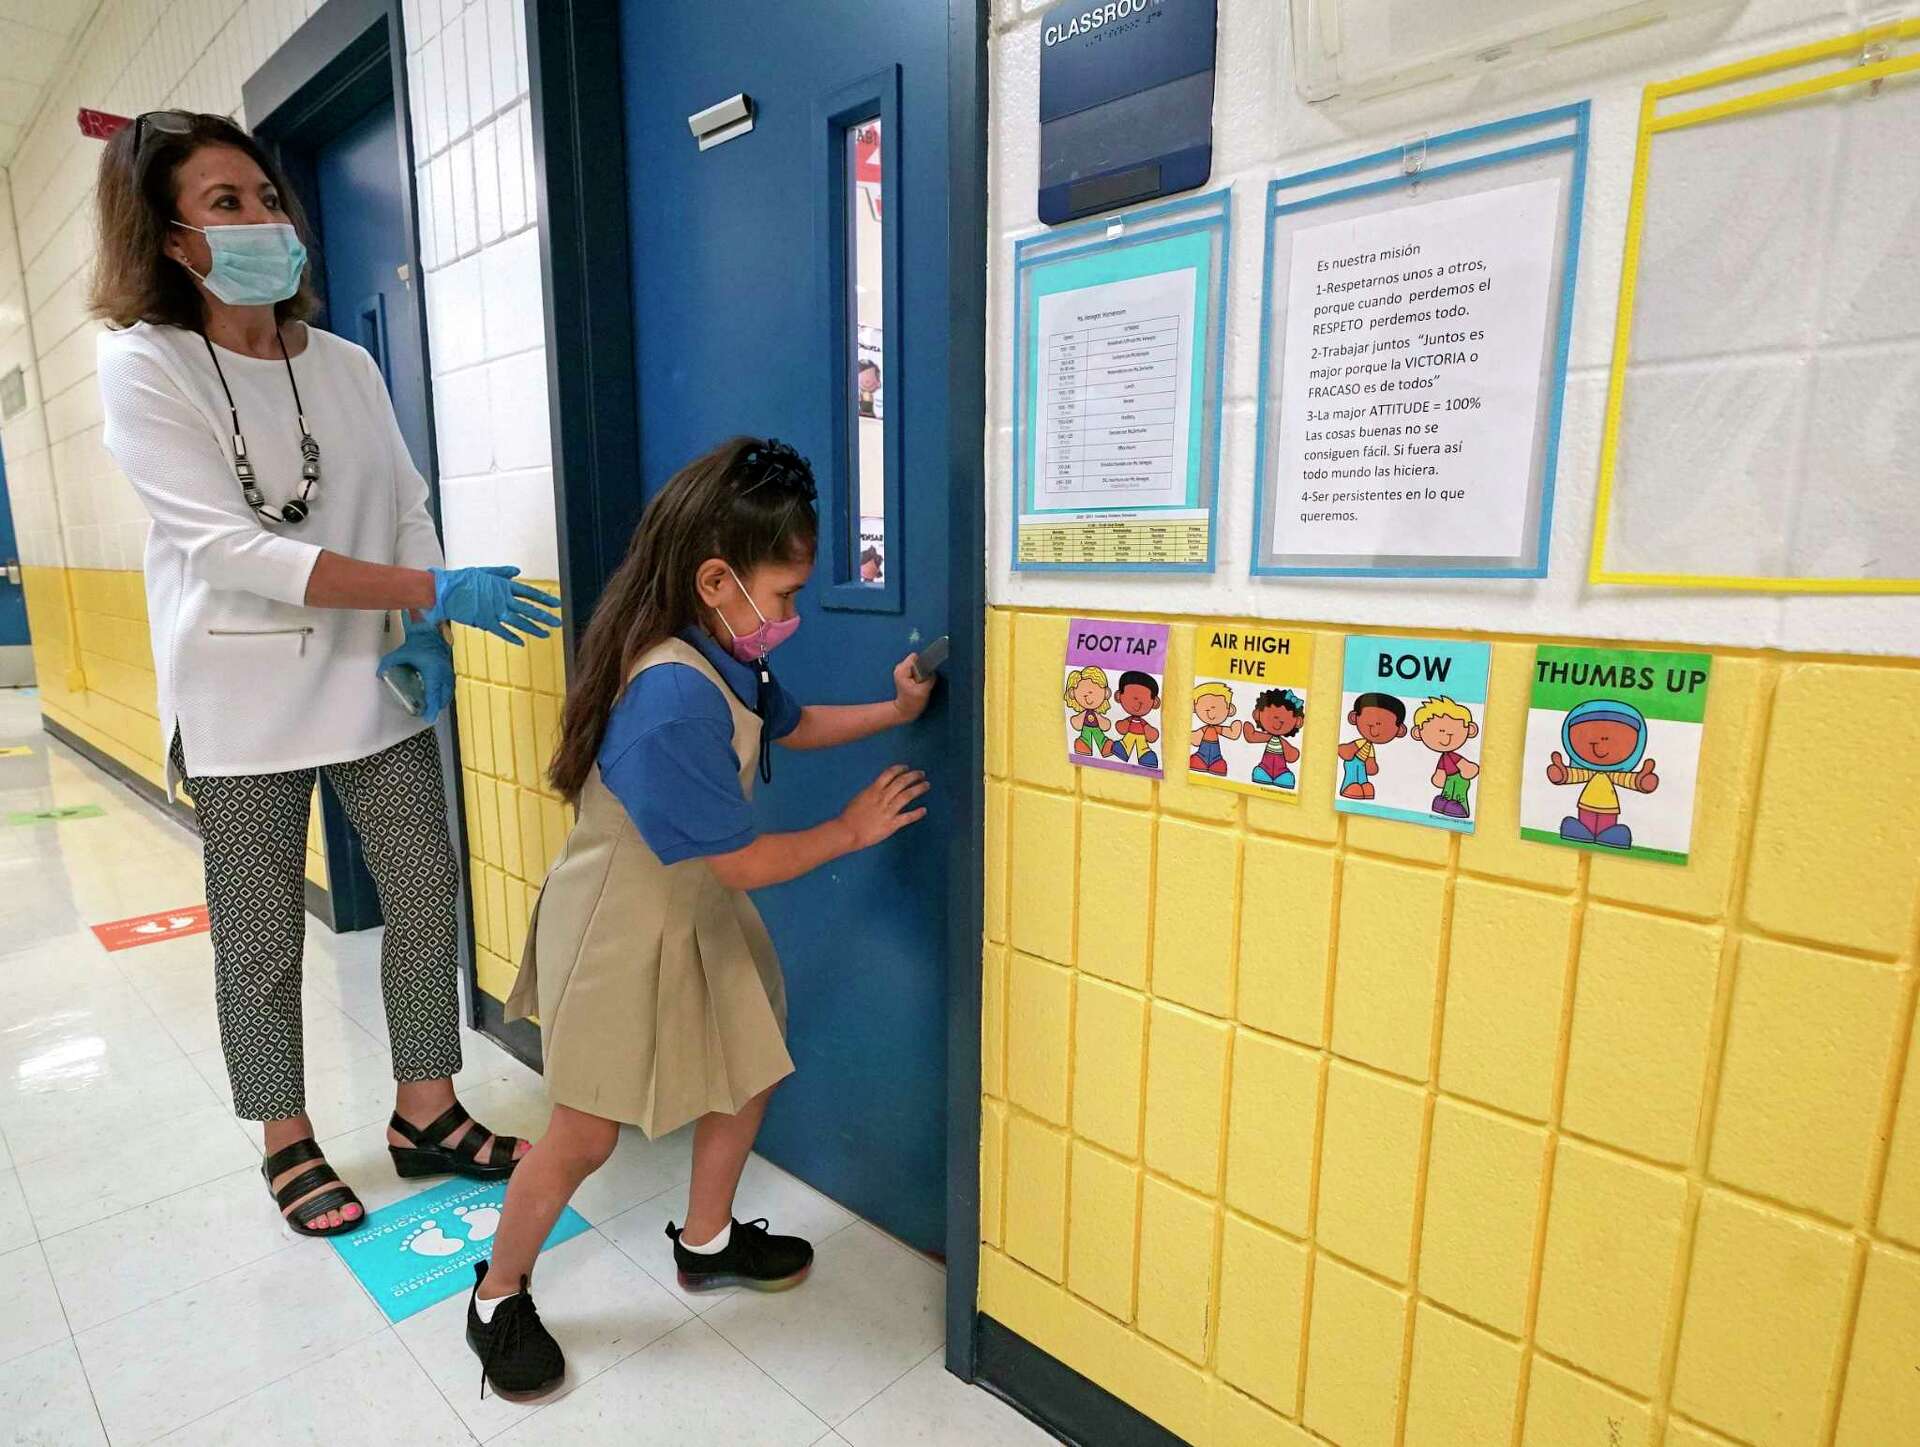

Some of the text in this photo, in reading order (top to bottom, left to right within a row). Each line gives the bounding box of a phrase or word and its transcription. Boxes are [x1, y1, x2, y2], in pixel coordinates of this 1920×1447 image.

[1316, 244, 1421, 272] Es nuestra misión
[1316, 259, 1487, 296] 1-Respetarnos unos a otros,
[1313, 277, 1491, 318] porque cuando perdemos el
[1312, 303, 1470, 336] RESPETO perdemos todo.
[1311, 343, 1369, 360] 2-Trabajar
[1371, 336, 1410, 355] juntos
[1469, 329, 1485, 341] es
[1309, 352, 1479, 380] major porque la VICTORIA o
[1308, 383, 1361, 398] FRACASO
[1364, 382, 1377, 393] es
[1380, 377, 1395, 392] de
[1306, 409, 1330, 422] 3-La
[1333, 406, 1367, 421] major
[1369, 400, 1430, 417] ATTITUDE
[1444, 396, 1481, 411] 100%
[1305, 422, 1439, 441] Las cosas buenas no se
[1304, 440, 1463, 462] consiguen fácil. Si fuera así
[1303, 464, 1439, 480] todo mundo las hiciera.
[1301, 487, 1465, 504] 4-Ser persistentes en lo que
[1300, 510, 1358, 524] queremos.
[1077, 633, 1157, 655] FOOT TAP
[1211, 632, 1290, 654] AIR HIGH
[1230, 658, 1266, 677] FIVE
[1377, 653, 1452, 682] BOW
[1537, 660, 1706, 694] THUMBS UP
[352, 1212, 426, 1247] PHYSICAL
